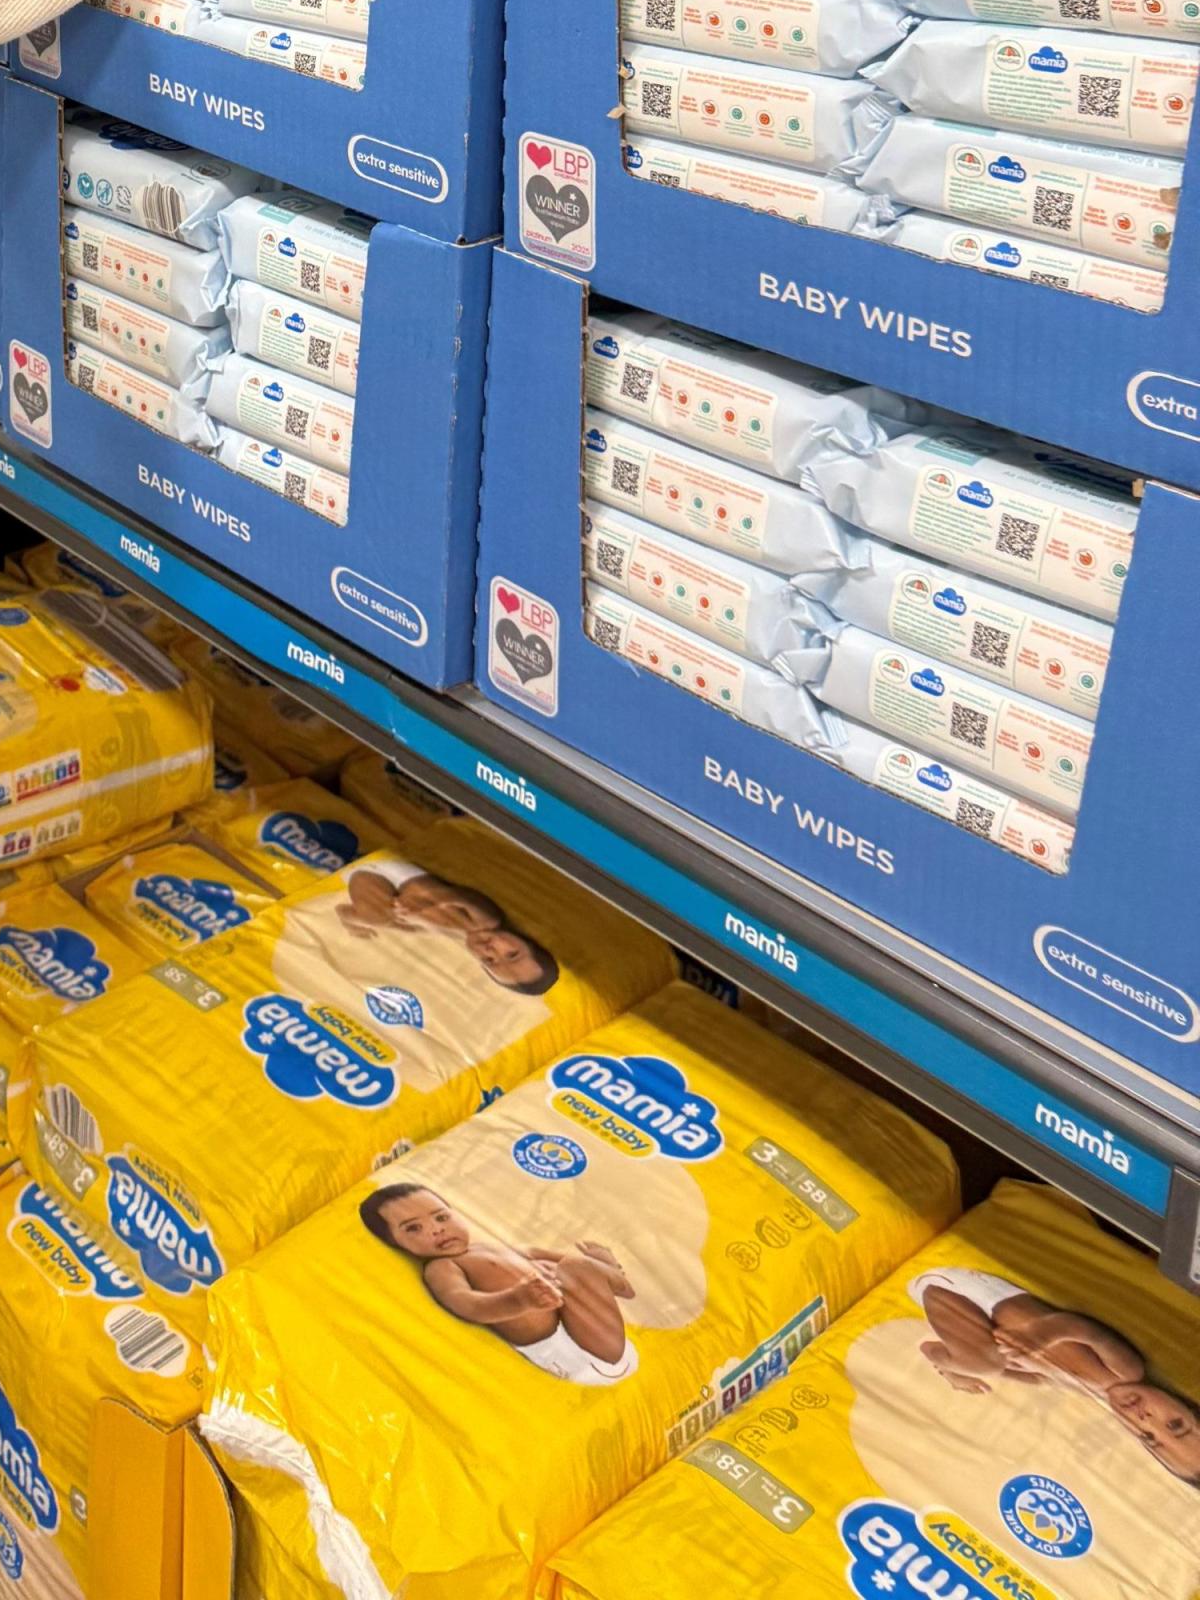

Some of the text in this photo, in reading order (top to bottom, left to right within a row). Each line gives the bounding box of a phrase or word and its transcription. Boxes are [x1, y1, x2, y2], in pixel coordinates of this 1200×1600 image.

[1029, 49, 1067, 68] mamia
[148, 73, 266, 132] BABY WIPES
[356, 150, 441, 191] extra sensitive
[553, 147, 590, 177] LBP
[990, 161, 1026, 181] mamia
[534, 191, 581, 219] WINNER
[758, 272, 974, 359] BABY WIPES
[27, 357, 49, 377] LBP
[1141, 390, 1198, 421] extra
[137, 464, 252, 543] BABY WIPES
[957, 484, 994, 508] mamia
[119, 533, 161, 574] mamia
[339, 582, 419, 633] extra sensitive
[520, 597, 554, 630] LBP
[286, 641, 346, 686] mamia
[503, 634, 546, 667] WINNER
[910, 671, 946, 696] mamia
[475, 760, 538, 813] mamia
[703, 754, 896, 875] BABY WIPES
[724, 910, 801, 974] mamia
[1047, 941, 1189, 1028] extra sensitive
[310, 1003, 351, 1038] baby
[257, 1002, 382, 1101] mamia
[353, 1030, 390, 1061] new
[560, 1092, 650, 1153] new baby
[564, 1056, 712, 1150] mamia
[1033, 1100, 1132, 1176] mamia
[752, 1142, 828, 1206] 3 58
[114, 1168, 213, 1278] mamia
[21, 1221, 87, 1286] new baby
[713, 1454, 804, 1526] 3 58
[1002, 1508, 1026, 1534] GIRL
[1035, 1542, 1064, 1558] BOY
